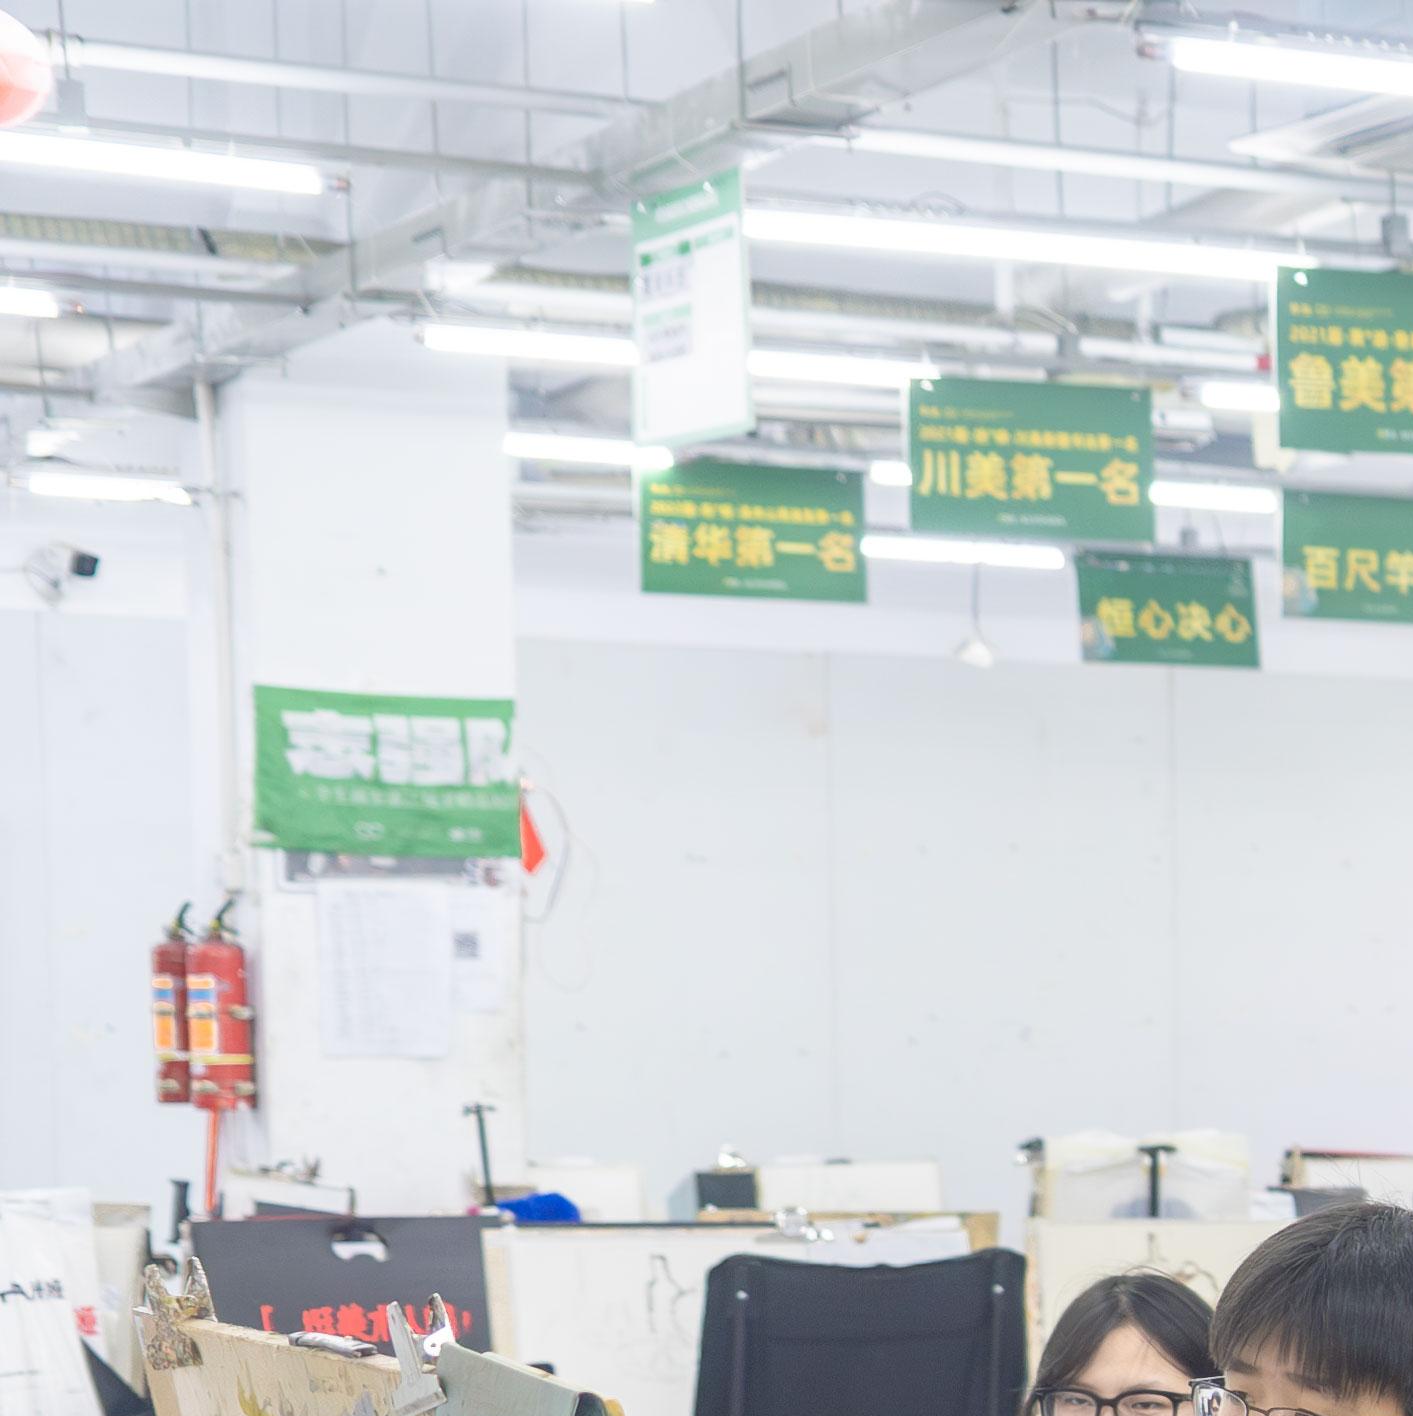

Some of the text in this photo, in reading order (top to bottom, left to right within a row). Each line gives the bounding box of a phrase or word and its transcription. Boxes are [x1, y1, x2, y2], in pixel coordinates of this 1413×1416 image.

[918, 448, 1140, 506] 川美第一名
[650, 520, 857, 573] 清华第一名
